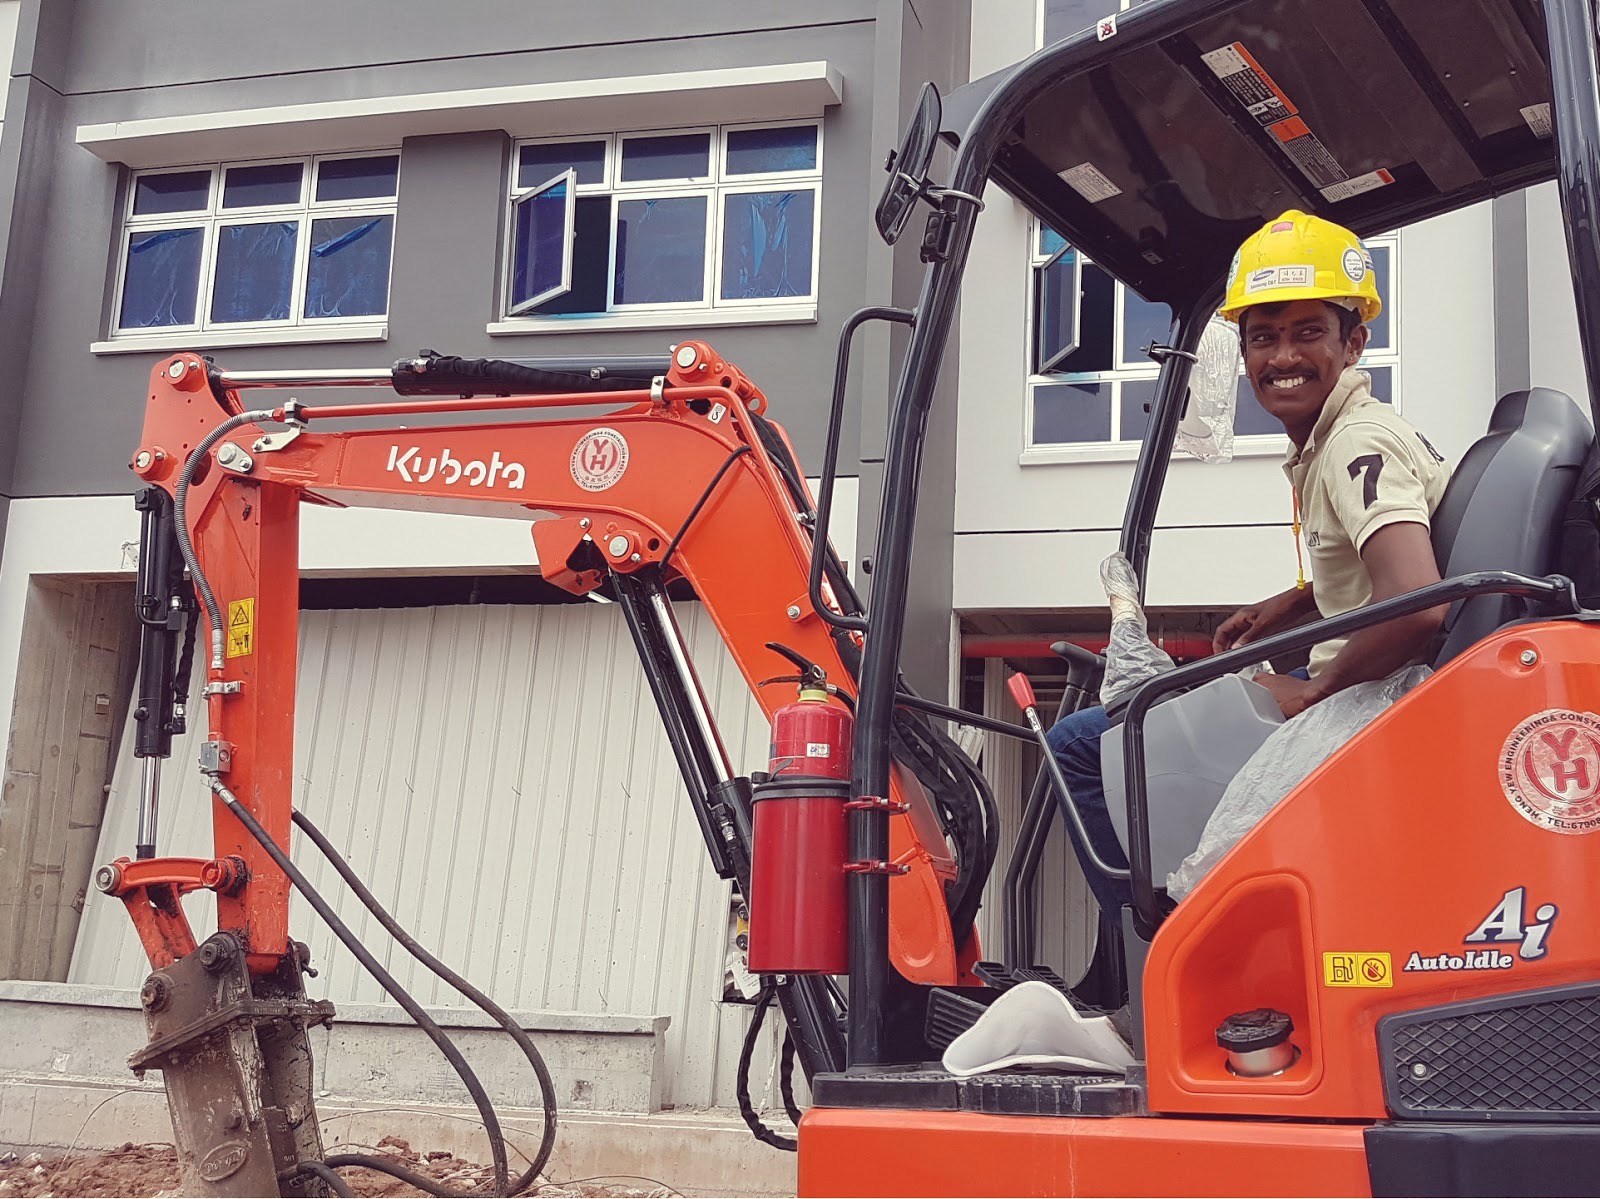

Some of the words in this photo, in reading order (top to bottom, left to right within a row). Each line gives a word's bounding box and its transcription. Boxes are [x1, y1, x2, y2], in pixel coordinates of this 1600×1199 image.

[386, 445, 526, 490] Kubota
[1346, 453, 1385, 511] 7
[1541, 727, 1578, 761] Y
[1504, 773, 1517, 795] YEW
[1550, 757, 1590, 793] H
[1514, 795, 1540, 819] HENG
[1465, 886, 1556, 959] Ai
[1403, 951, 1513, 971] AutoIdle
